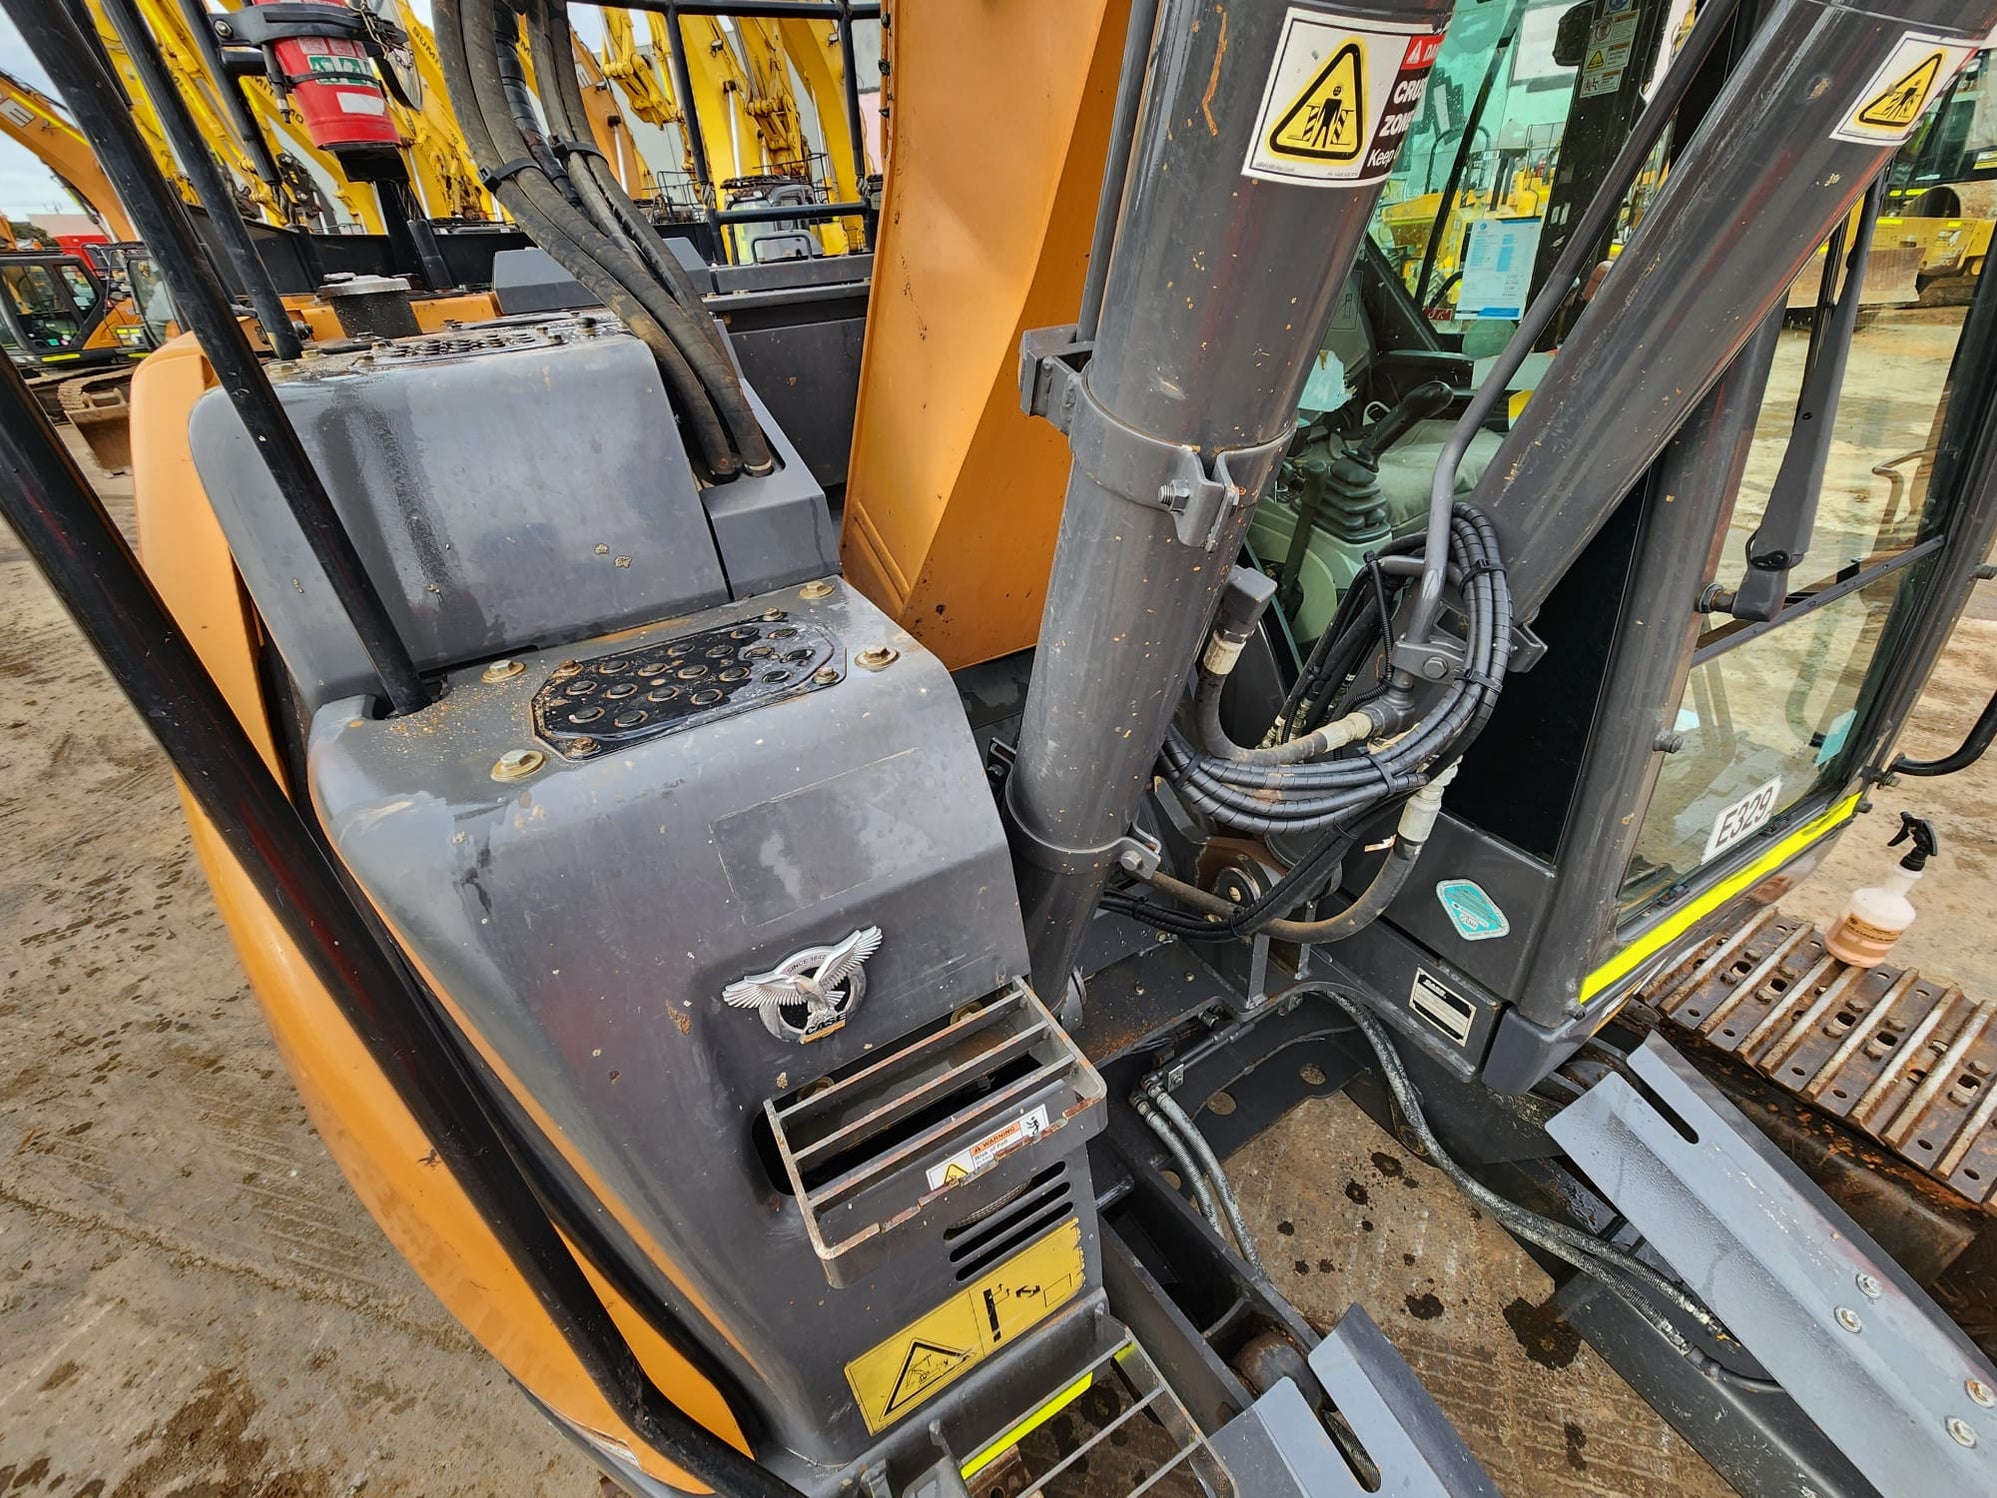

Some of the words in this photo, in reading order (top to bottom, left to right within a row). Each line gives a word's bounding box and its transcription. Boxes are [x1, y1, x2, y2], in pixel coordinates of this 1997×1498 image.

[1367, 148, 1395, 168] Keep
[1715, 786, 1773, 848] E329
[786, 959, 807, 973] SINCE
[804, 1012, 847, 1035] CASE
[983, 1125, 1016, 1148] WARNING
